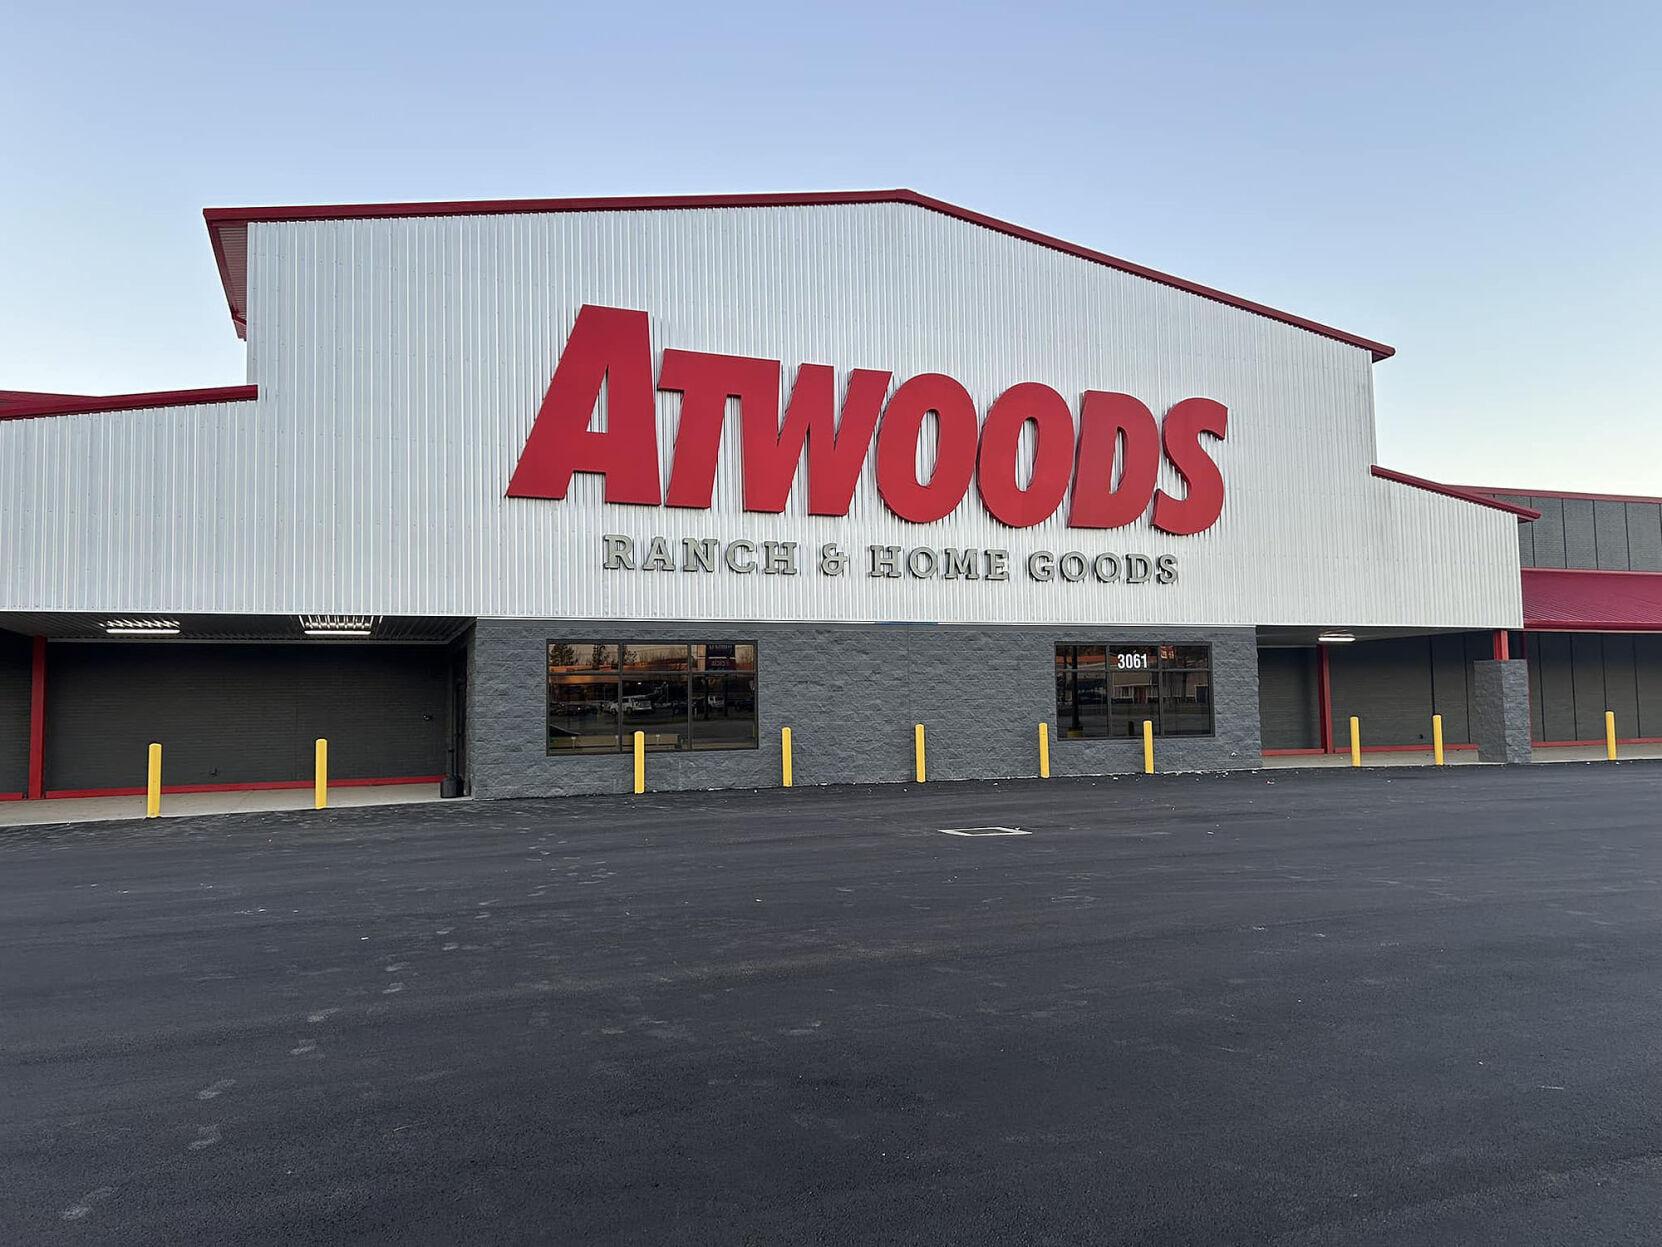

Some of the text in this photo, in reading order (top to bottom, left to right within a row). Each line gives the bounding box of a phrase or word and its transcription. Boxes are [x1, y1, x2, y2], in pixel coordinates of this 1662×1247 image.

[505, 304, 1228, 535] ATWOODS
[603, 535, 1179, 584] RANCH & HOME GOODS
[1117, 653, 1148, 669] 3061
